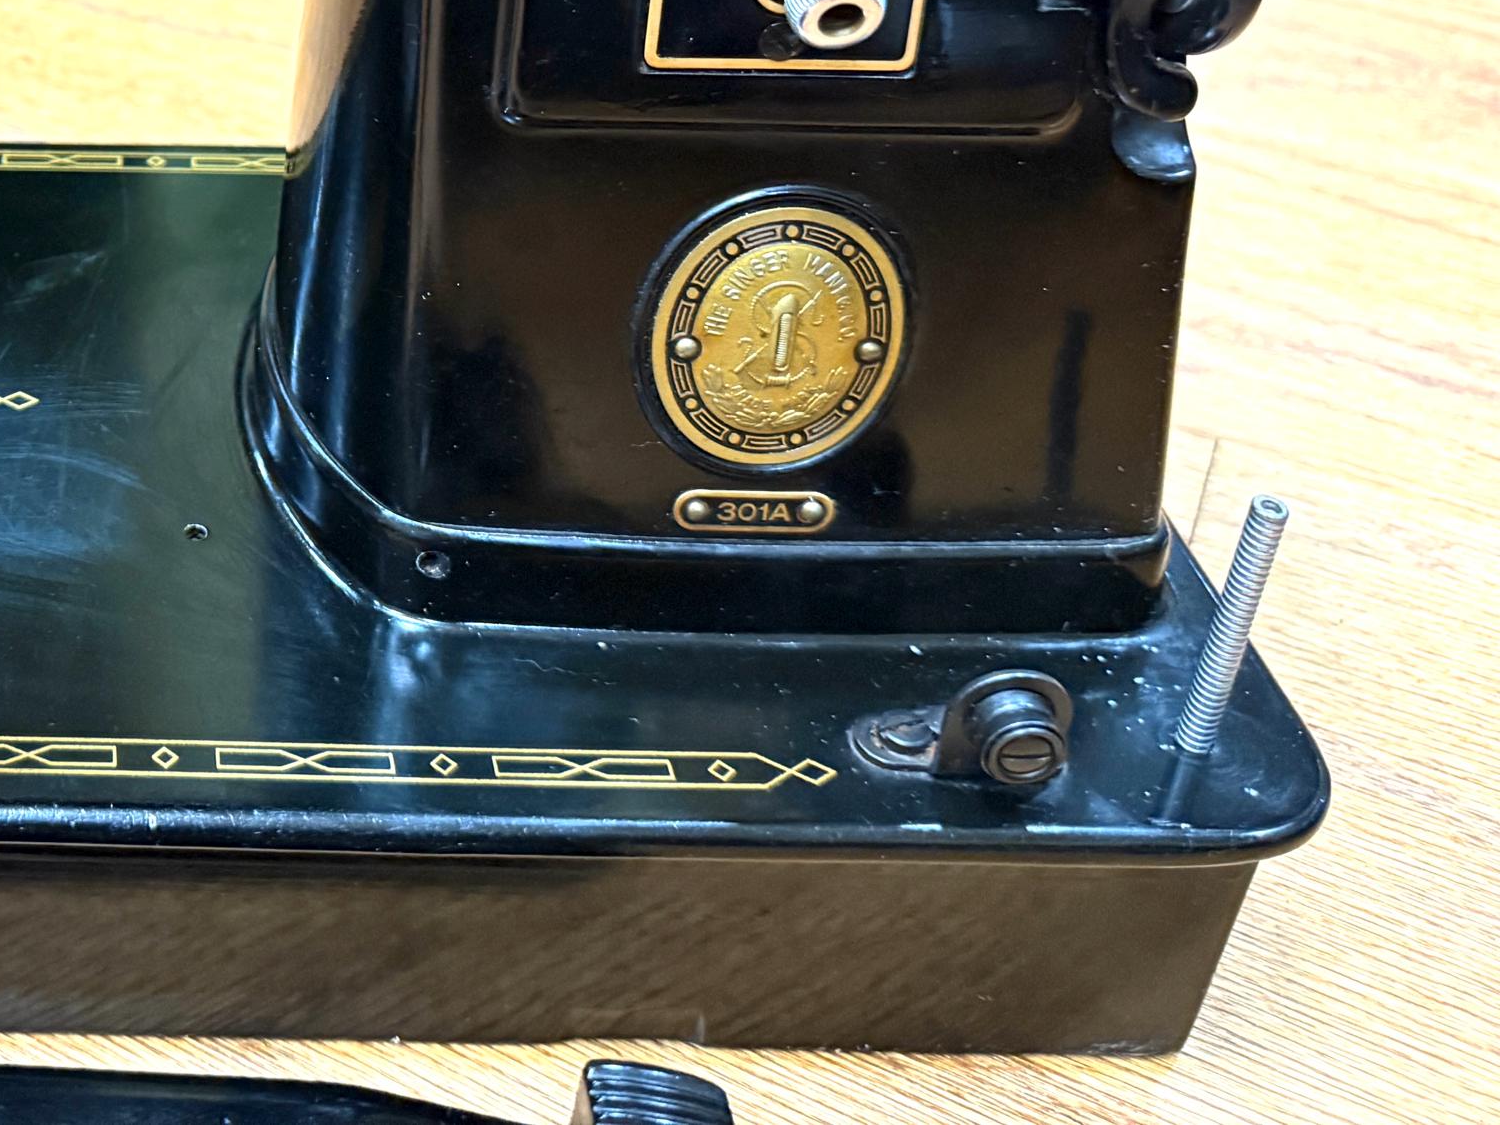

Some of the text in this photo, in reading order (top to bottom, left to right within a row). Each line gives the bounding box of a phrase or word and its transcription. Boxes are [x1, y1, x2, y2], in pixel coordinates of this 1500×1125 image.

[704, 302, 733, 336] THE
[721, 250, 789, 300] SINGER
[716, 501, 791, 523] 301A
